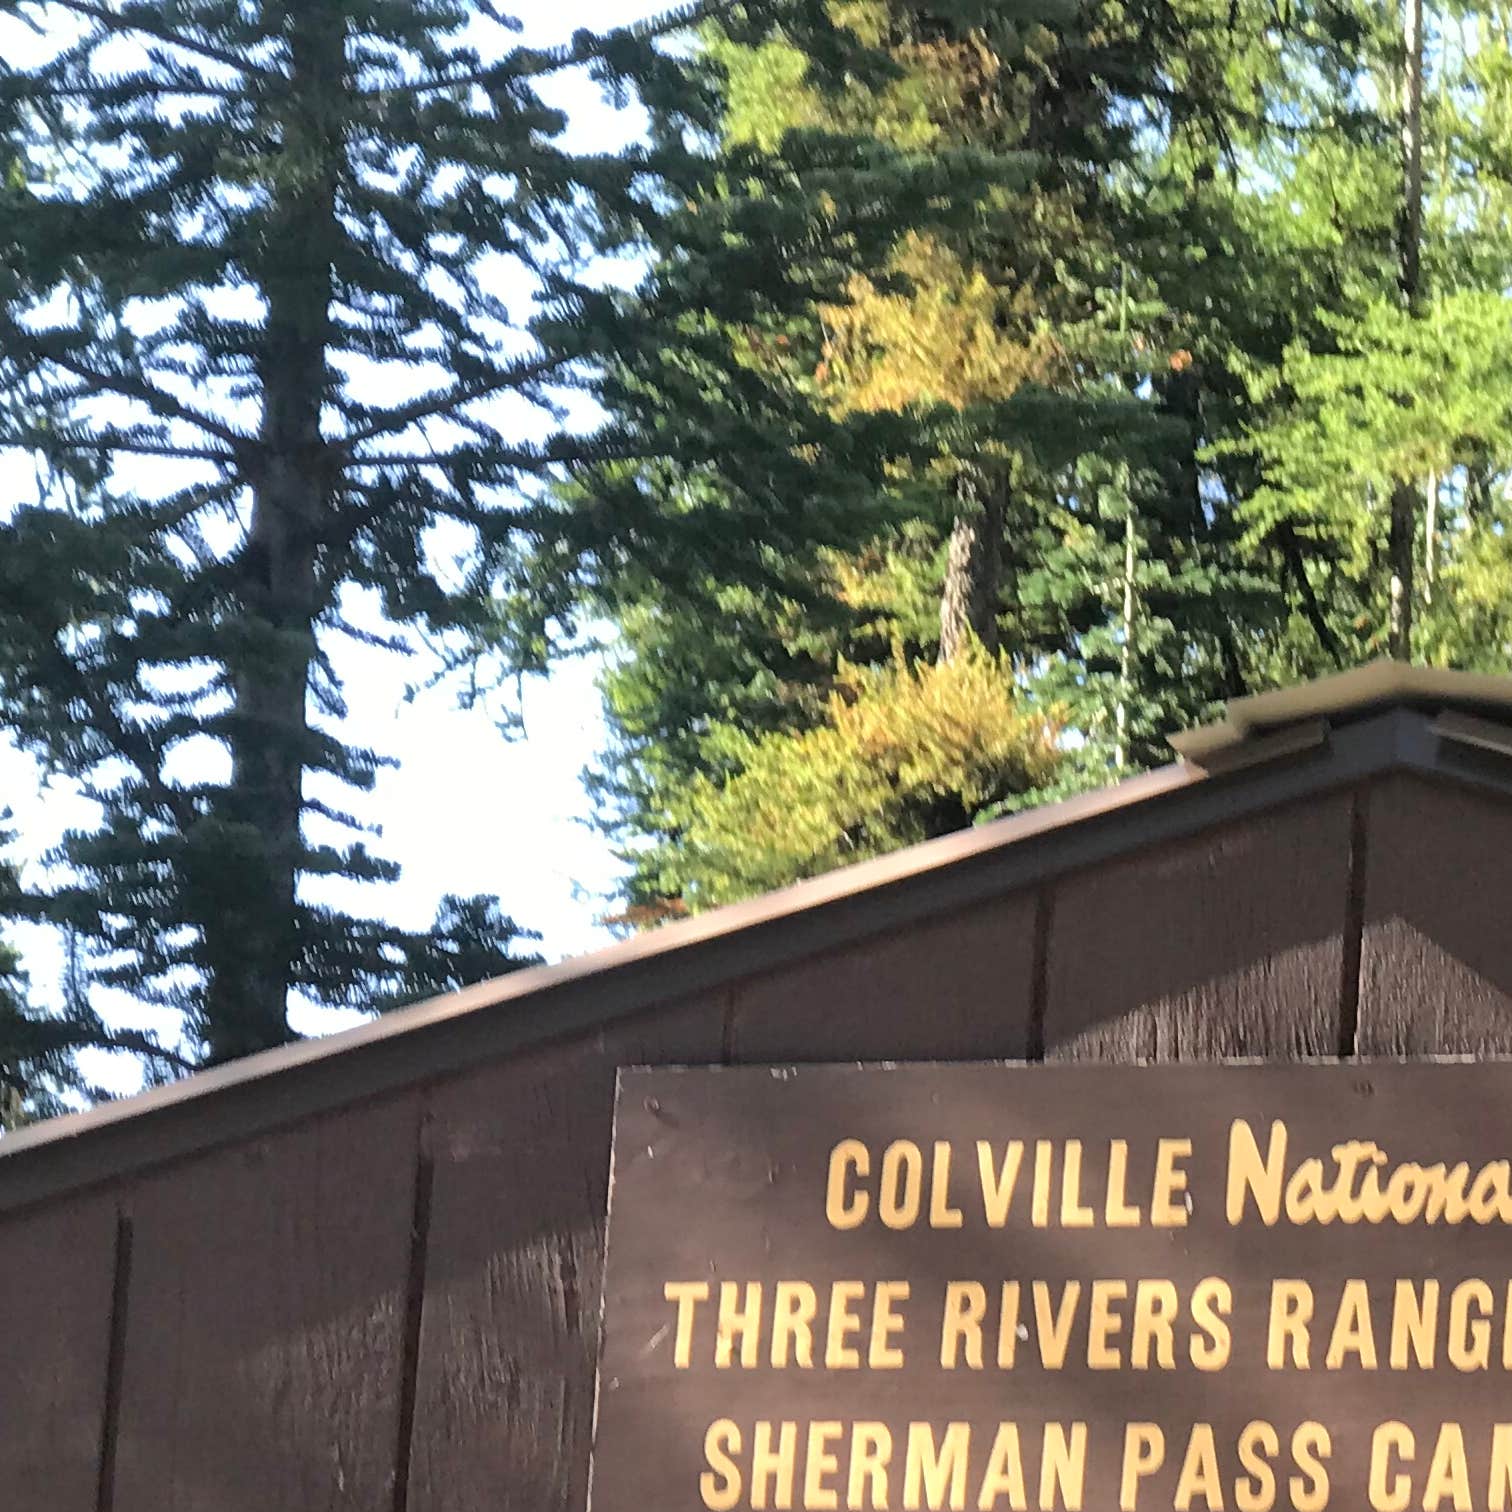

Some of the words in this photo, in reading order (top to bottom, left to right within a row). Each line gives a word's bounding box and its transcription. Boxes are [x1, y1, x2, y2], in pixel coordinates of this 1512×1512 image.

[826, 1138, 1191, 1229] COLVILLE
[664, 1281, 910, 1368] THREE
[941, 1276, 1231, 1370] RIVERS
[700, 1418, 1086, 1512] SHERMAN
